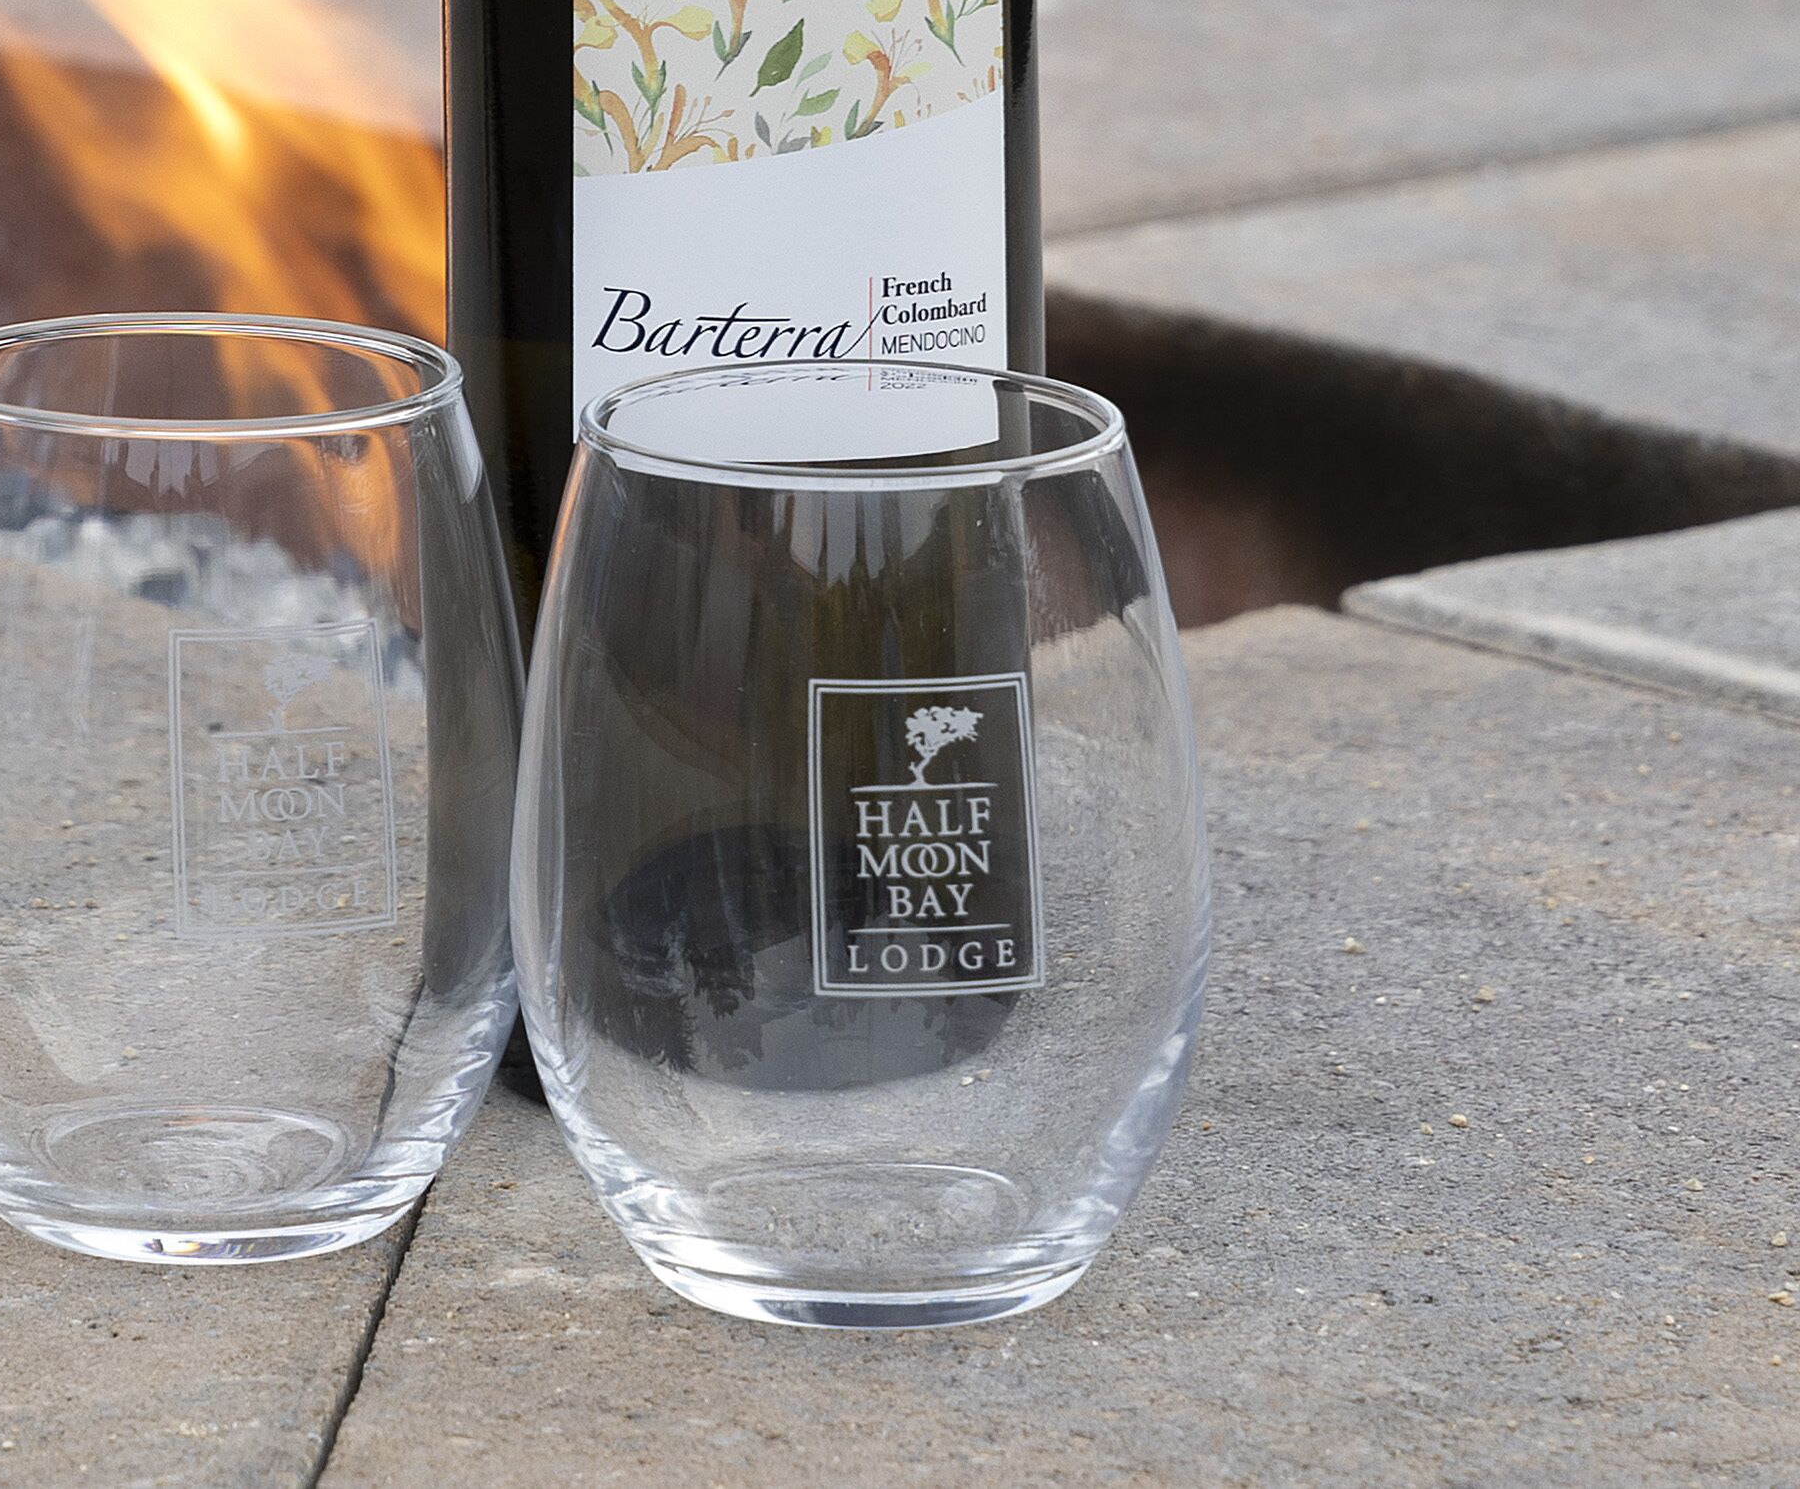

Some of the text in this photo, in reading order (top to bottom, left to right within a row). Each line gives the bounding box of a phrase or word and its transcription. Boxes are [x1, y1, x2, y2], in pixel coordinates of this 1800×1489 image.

[882, 272, 952, 298] French
[591, 287, 884, 359] Barterra
[882, 293, 986, 325] Colombard
[881, 324, 986, 355] MENDOCINO
[217, 742, 345, 783] HALF
[218, 784, 347, 822] MOON
[855, 797, 991, 837] HALF
[857, 841, 991, 878] MOON
[887, 883, 974, 918] BAY
[848, 939, 1016, 972] LODGE
